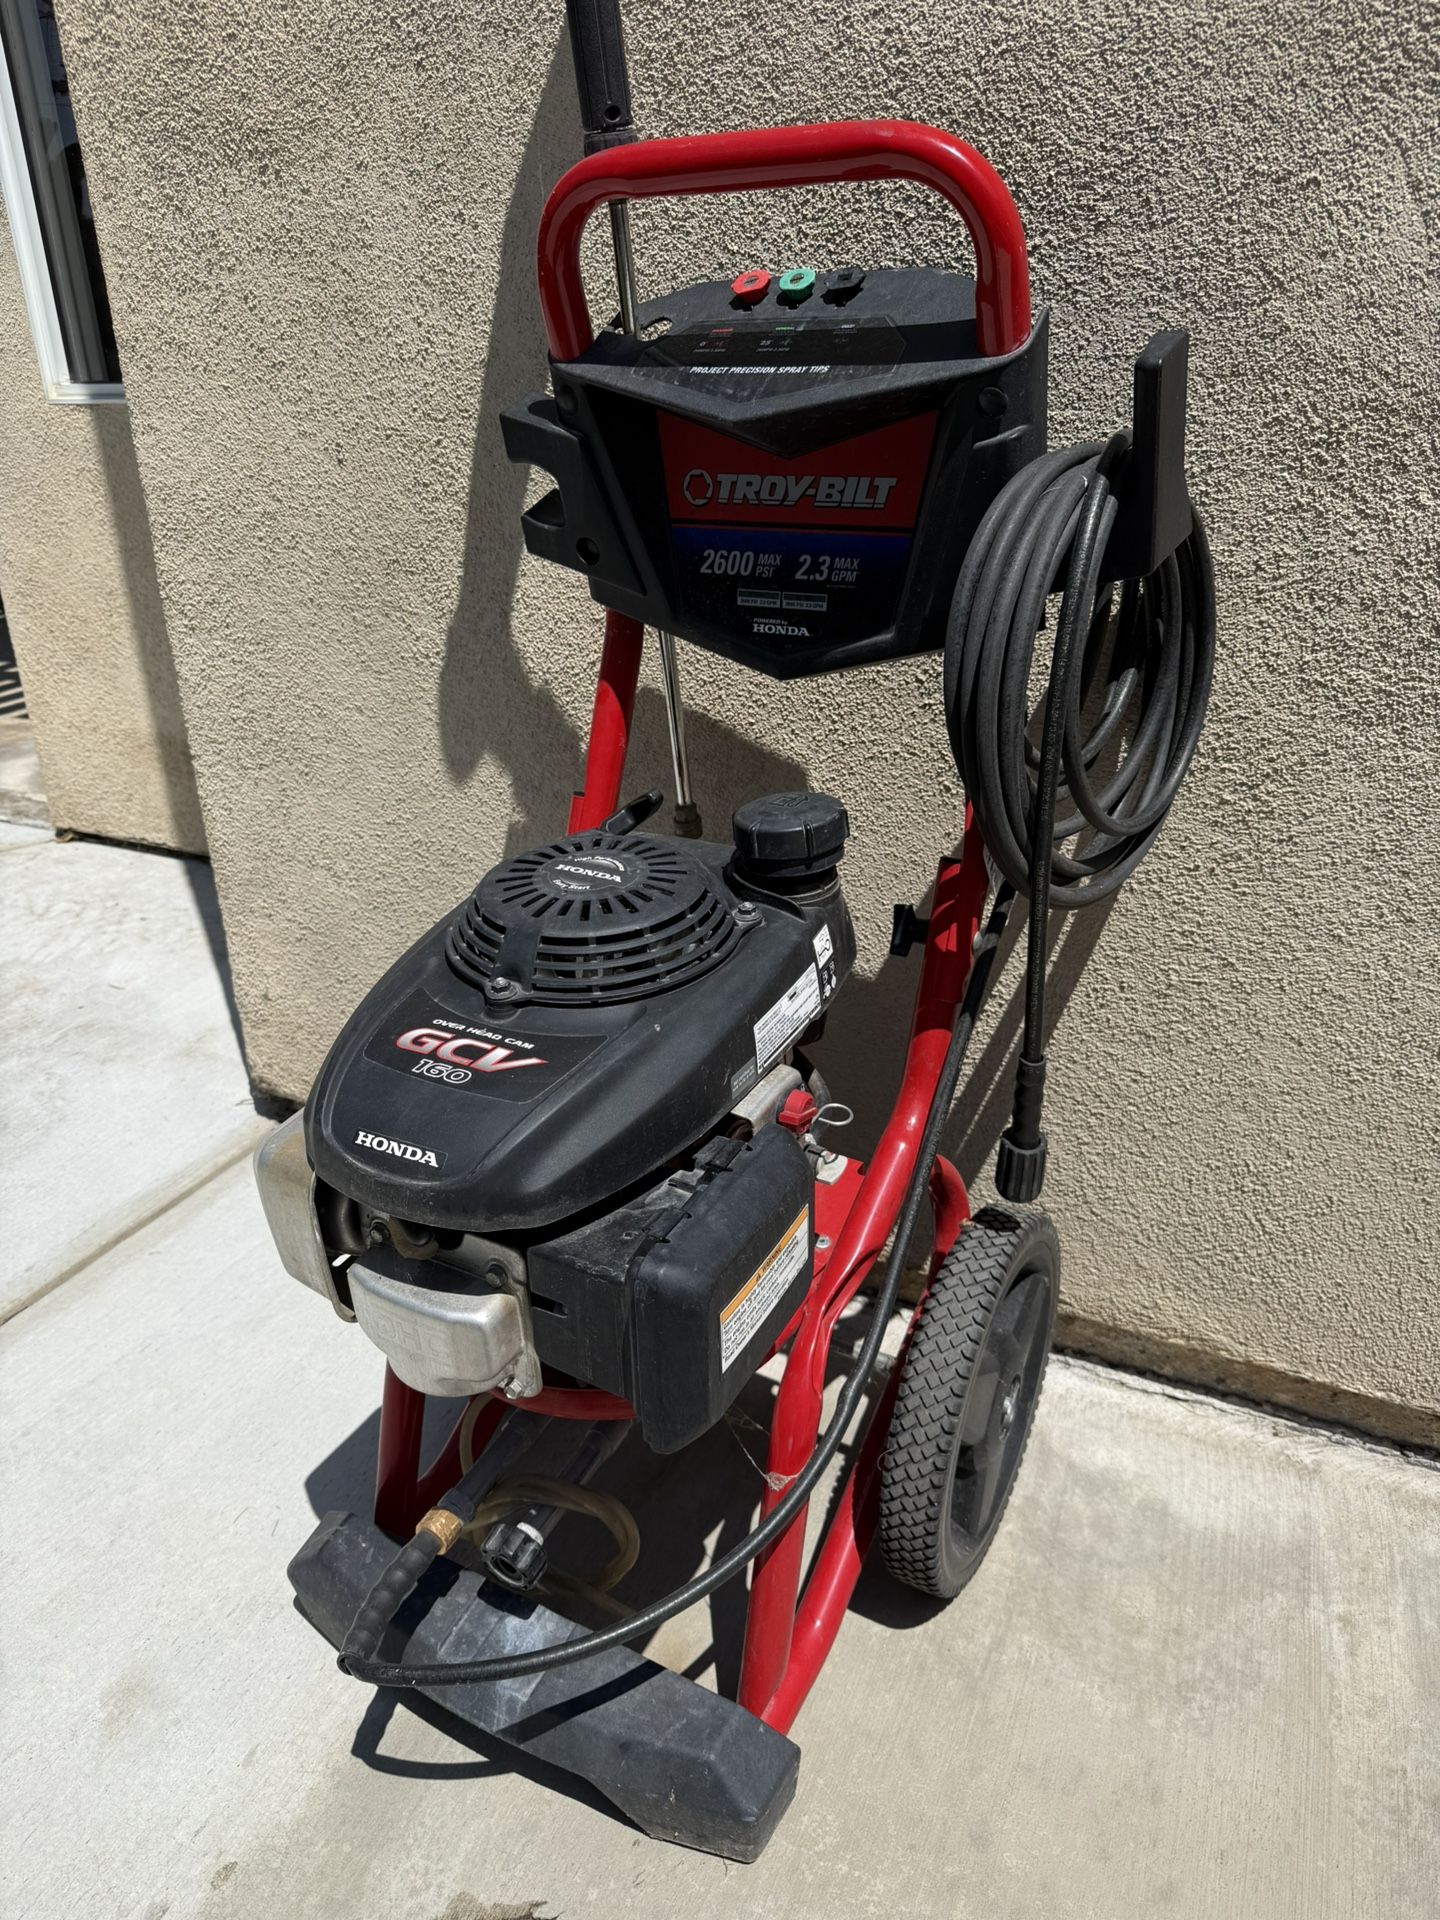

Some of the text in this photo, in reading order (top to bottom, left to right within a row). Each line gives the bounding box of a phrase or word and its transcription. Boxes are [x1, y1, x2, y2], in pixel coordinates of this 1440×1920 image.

[689, 365, 831, 374] PROJECT PRECISION SPRAY TIPS
[716, 474, 897, 508] TROY-BILT
[699, 549, 754, 576] 2600
[757, 553, 782, 566] MAX
[794, 554, 831, 581] 2.3
[833, 557, 861, 570] MAX
[752, 623, 810, 637] HONDA
[555, 864, 622, 883] HONDA
[432, 1019, 535, 1050] OVER HEAD CAM
[395, 1027, 549, 1073] GCV
[412, 1058, 472, 1084] 160
[355, 1130, 439, 1168] HONDA
